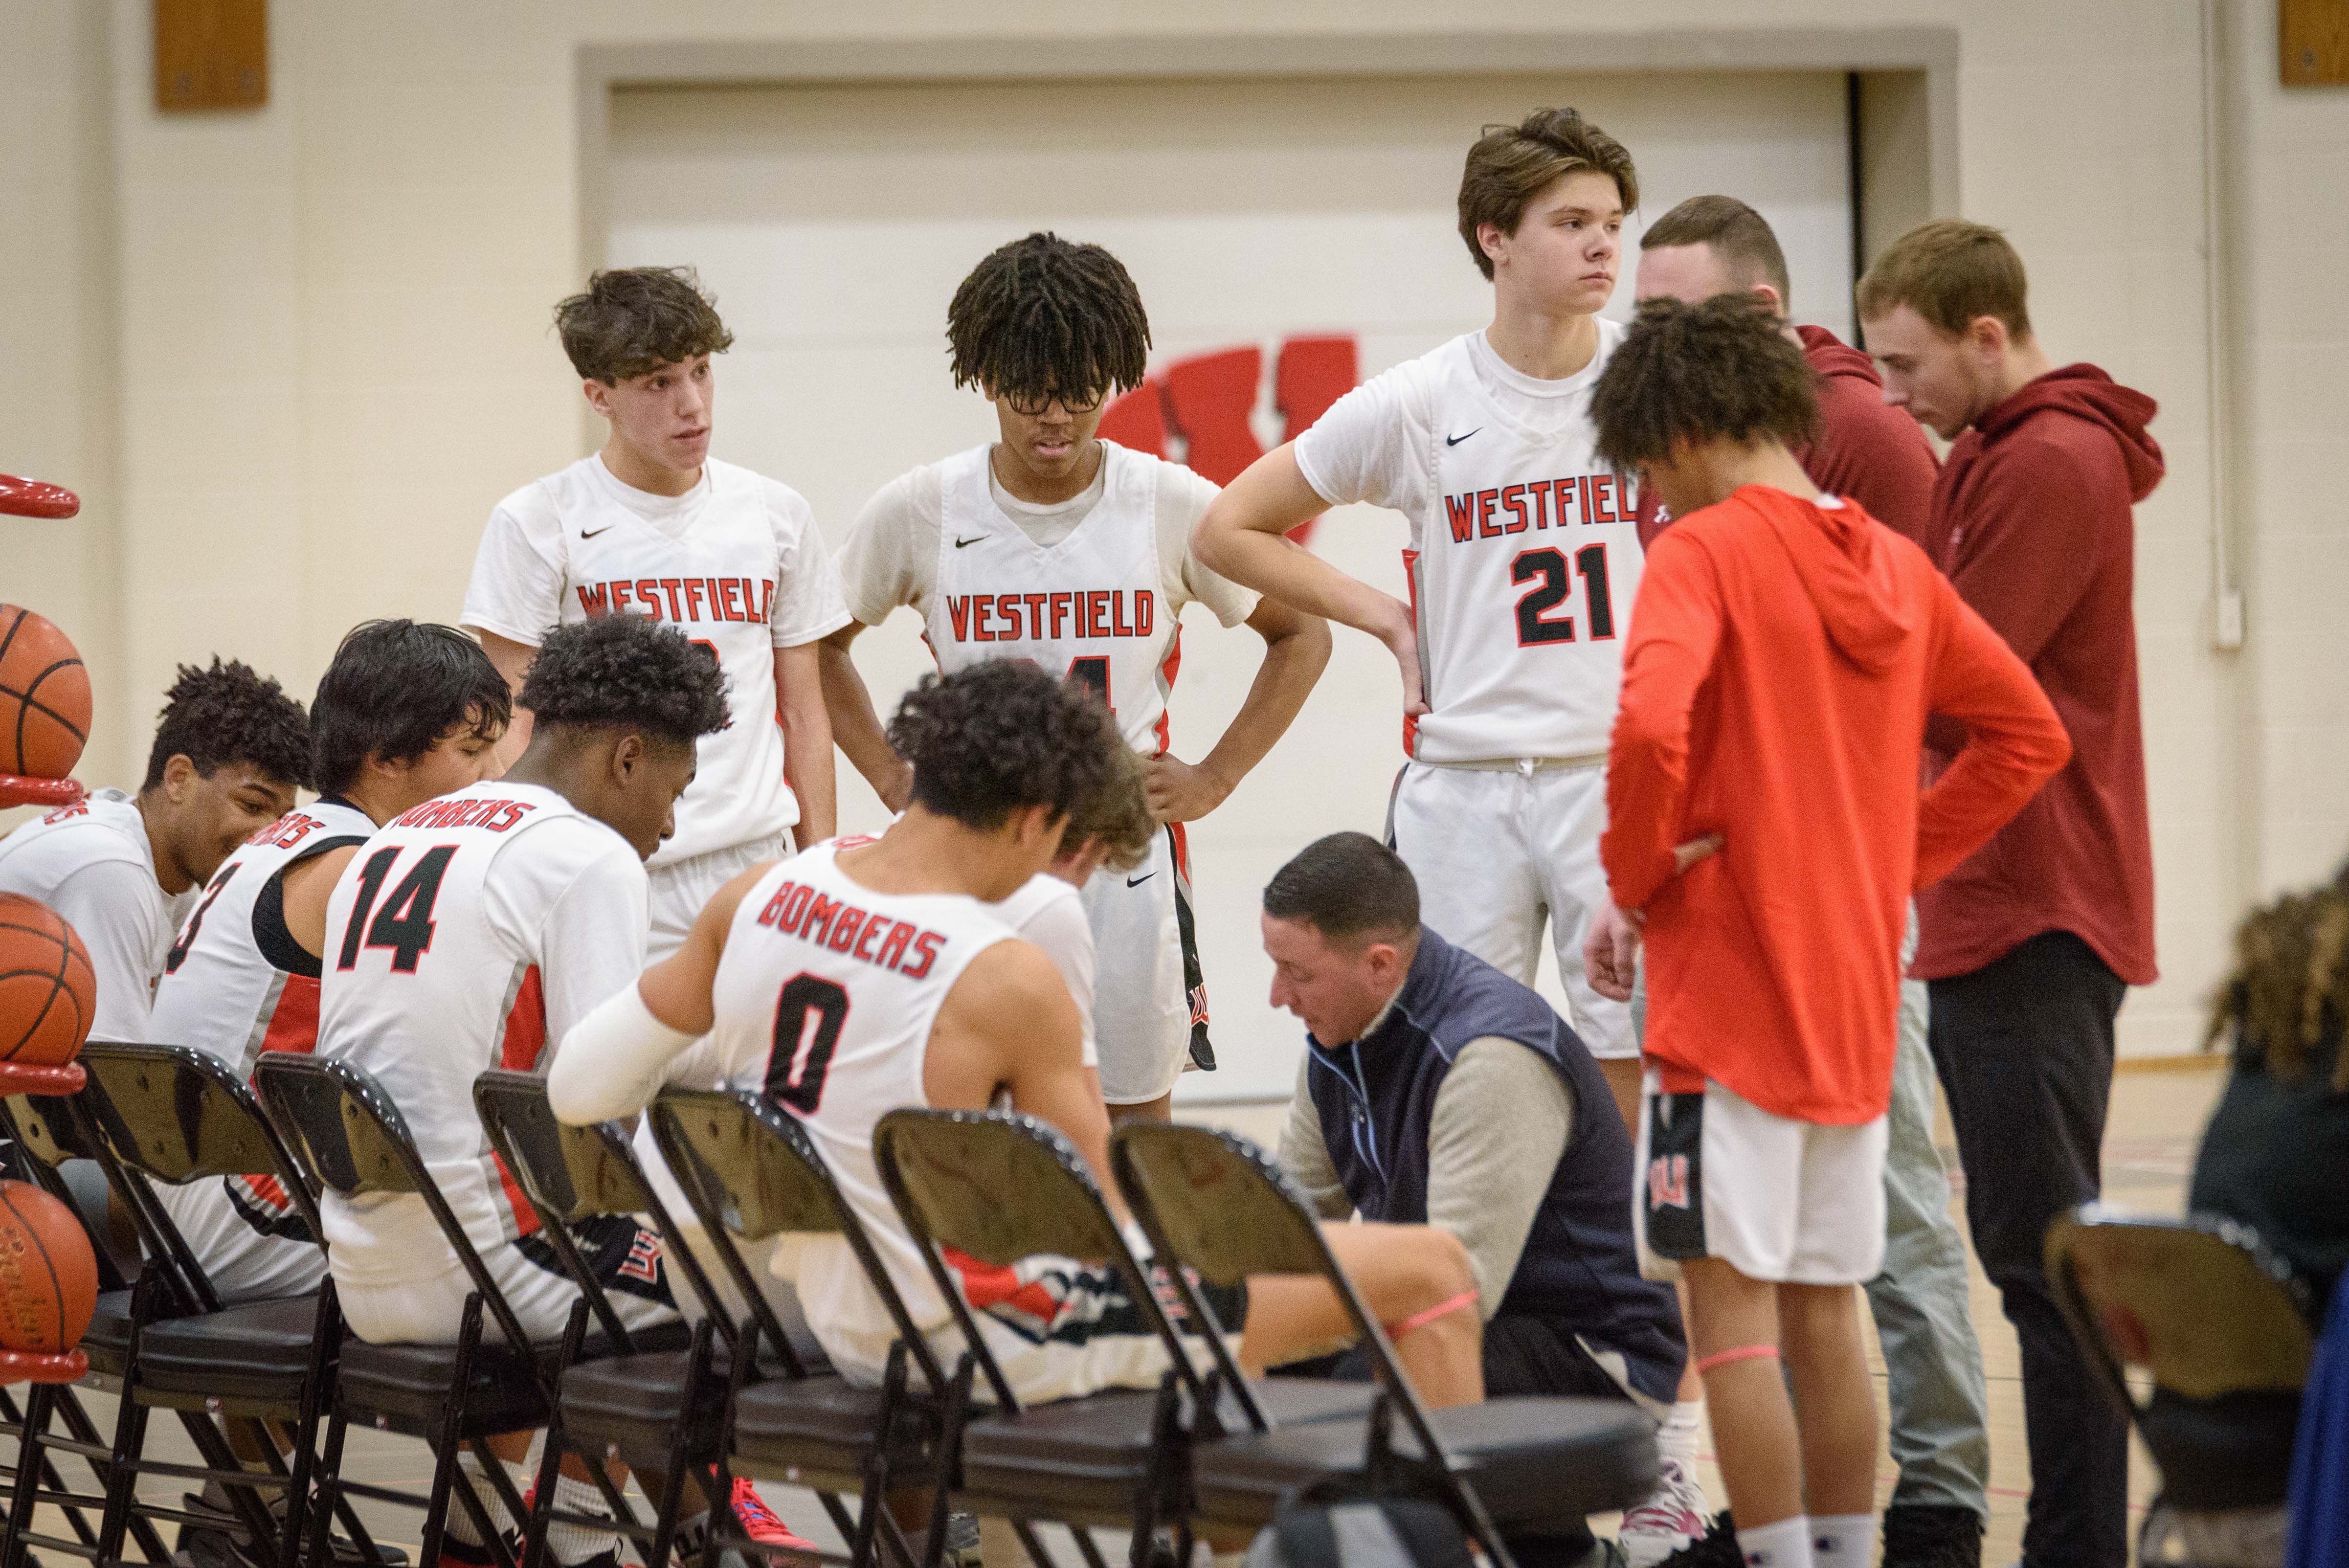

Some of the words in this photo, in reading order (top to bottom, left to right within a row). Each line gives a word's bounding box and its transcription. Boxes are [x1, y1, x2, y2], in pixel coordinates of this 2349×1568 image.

[1444, 474, 1636, 544] WESTFIEL
[946, 590, 1154, 642] WESTFIELD
[1510, 542, 1616, 648] 21
[336, 845, 461, 975] 14
[758, 880, 948, 980] BOMBERS
